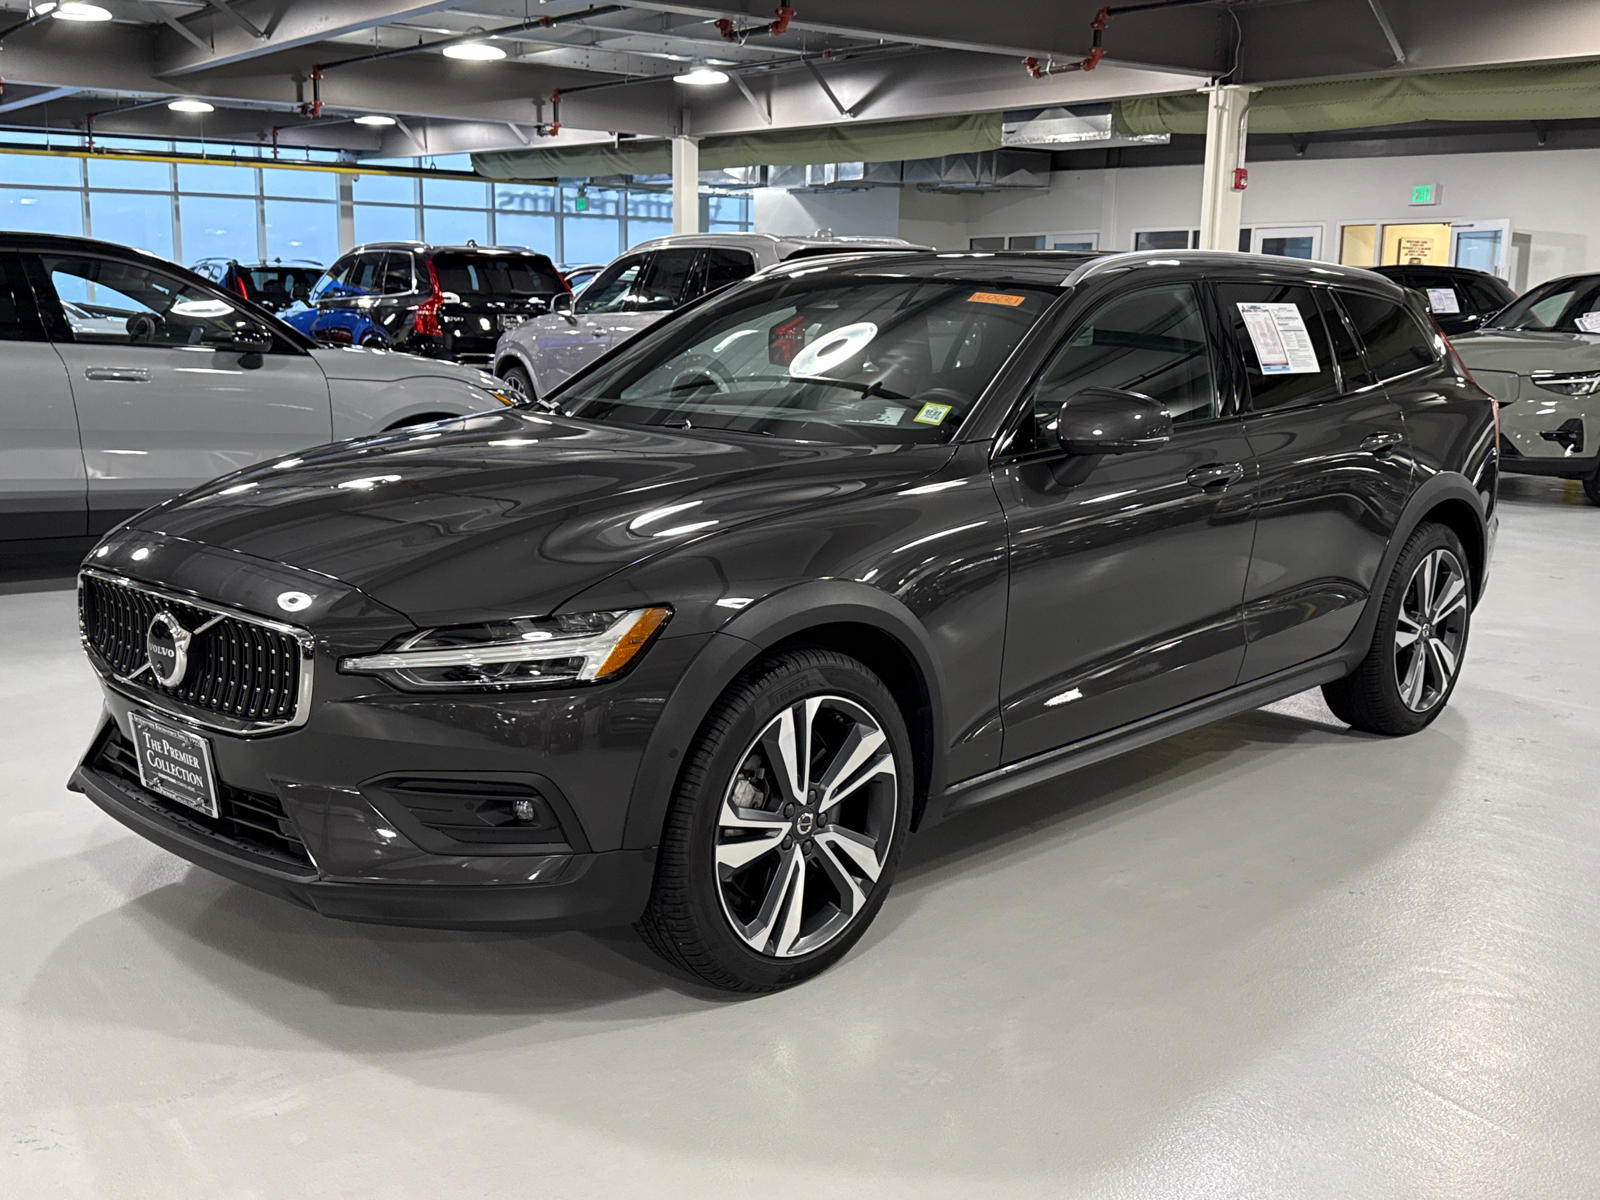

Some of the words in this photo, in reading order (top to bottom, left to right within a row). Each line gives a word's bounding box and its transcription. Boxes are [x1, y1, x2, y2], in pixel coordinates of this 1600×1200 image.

[1412, 185, 1432, 203] EXIT
[149, 642, 175, 658] VOLVO
[143, 732, 163, 754] THE
[162, 739, 200, 769] PREMIER
[147, 750, 204, 788] COLLECTION
